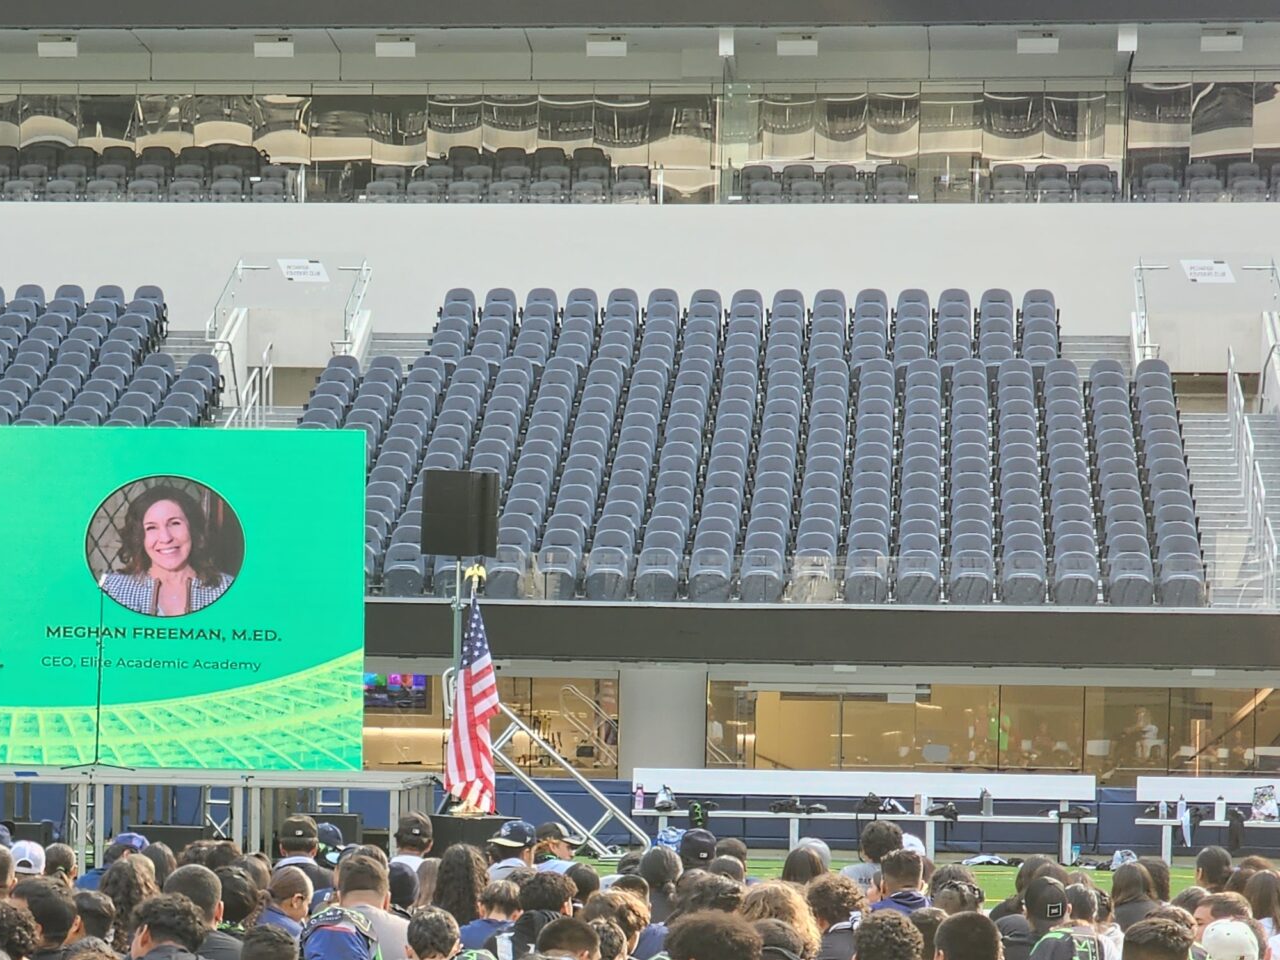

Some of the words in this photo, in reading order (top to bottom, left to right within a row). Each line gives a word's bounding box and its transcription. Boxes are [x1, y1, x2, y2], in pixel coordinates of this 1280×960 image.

[46, 626, 126, 638] MEGHAN
[133, 628, 226, 642] FREEMAN,
[232, 629, 282, 641] M.ED.
[41, 656, 76, 668] CEO,
[116, 658, 188, 669] Academic
[193, 659, 261, 672] Academy
